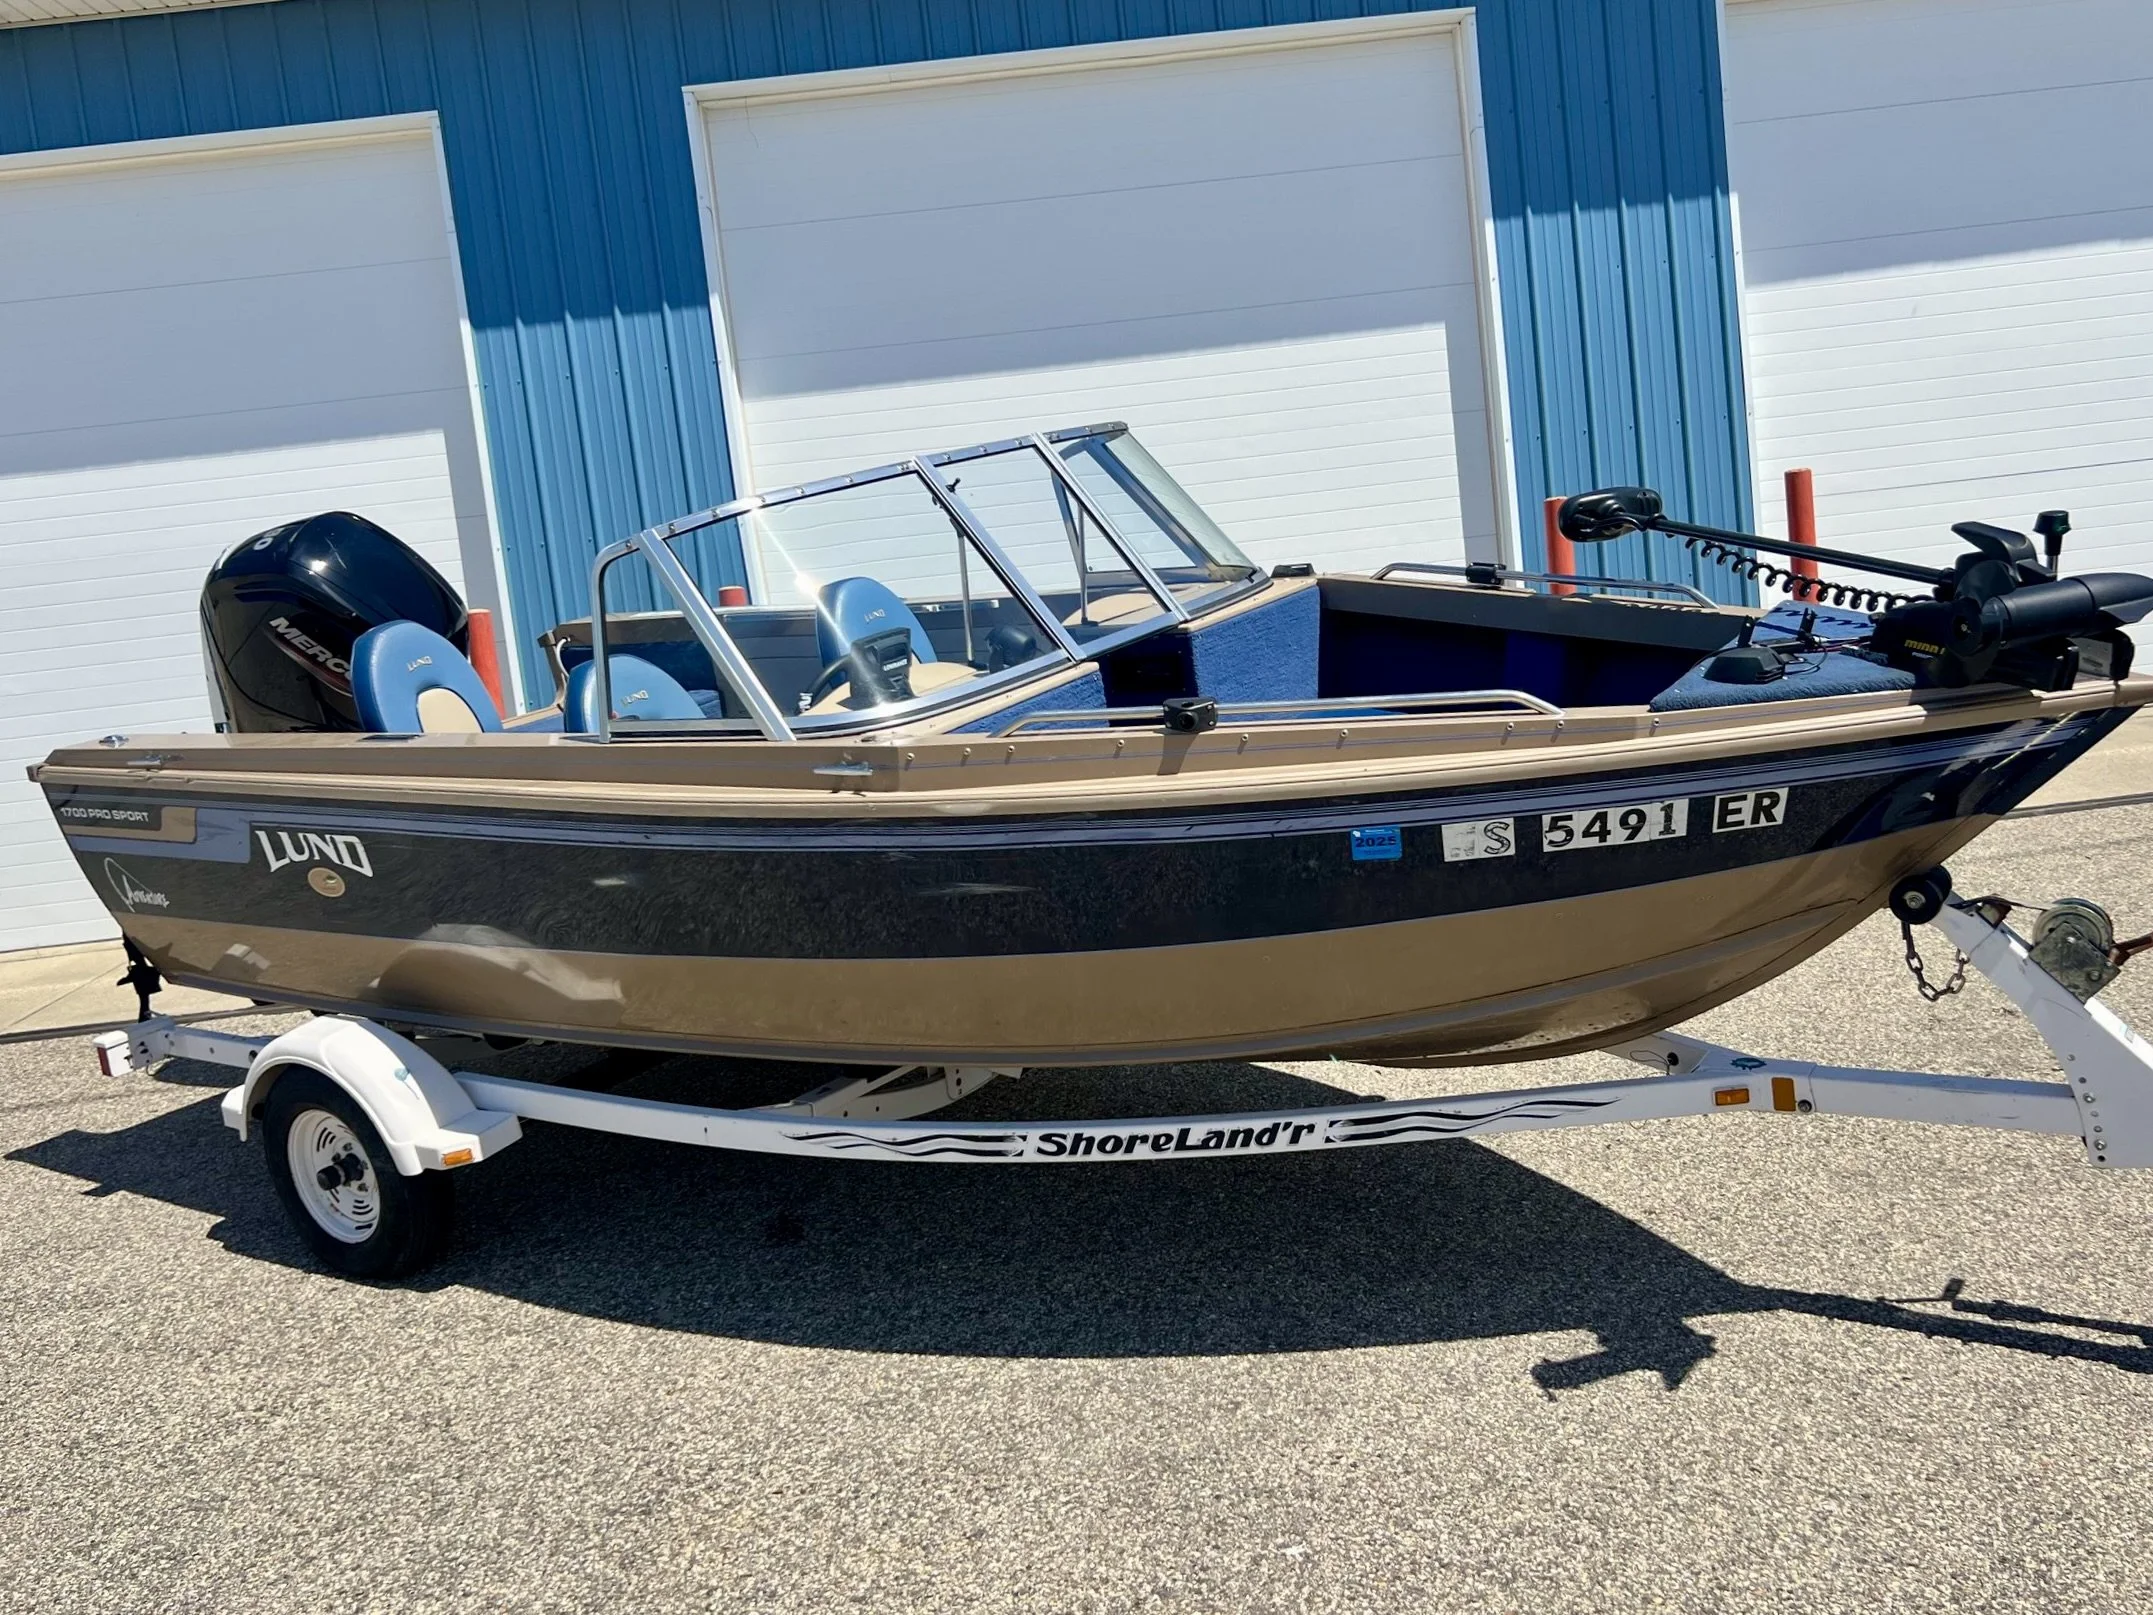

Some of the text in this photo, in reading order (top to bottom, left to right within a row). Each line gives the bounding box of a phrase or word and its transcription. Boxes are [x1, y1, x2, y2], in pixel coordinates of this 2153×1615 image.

[406, 655, 432, 671] LUND
[60, 807, 149, 822] 1700 PRO SPORT
[1544, 803, 1677, 848] 5491
[1716, 791, 1781, 830] ER
[255, 830, 373, 877] LUND
[1355, 835, 1397, 848] 2025
[1036, 1121, 1316, 1157] ShoreLand'r
